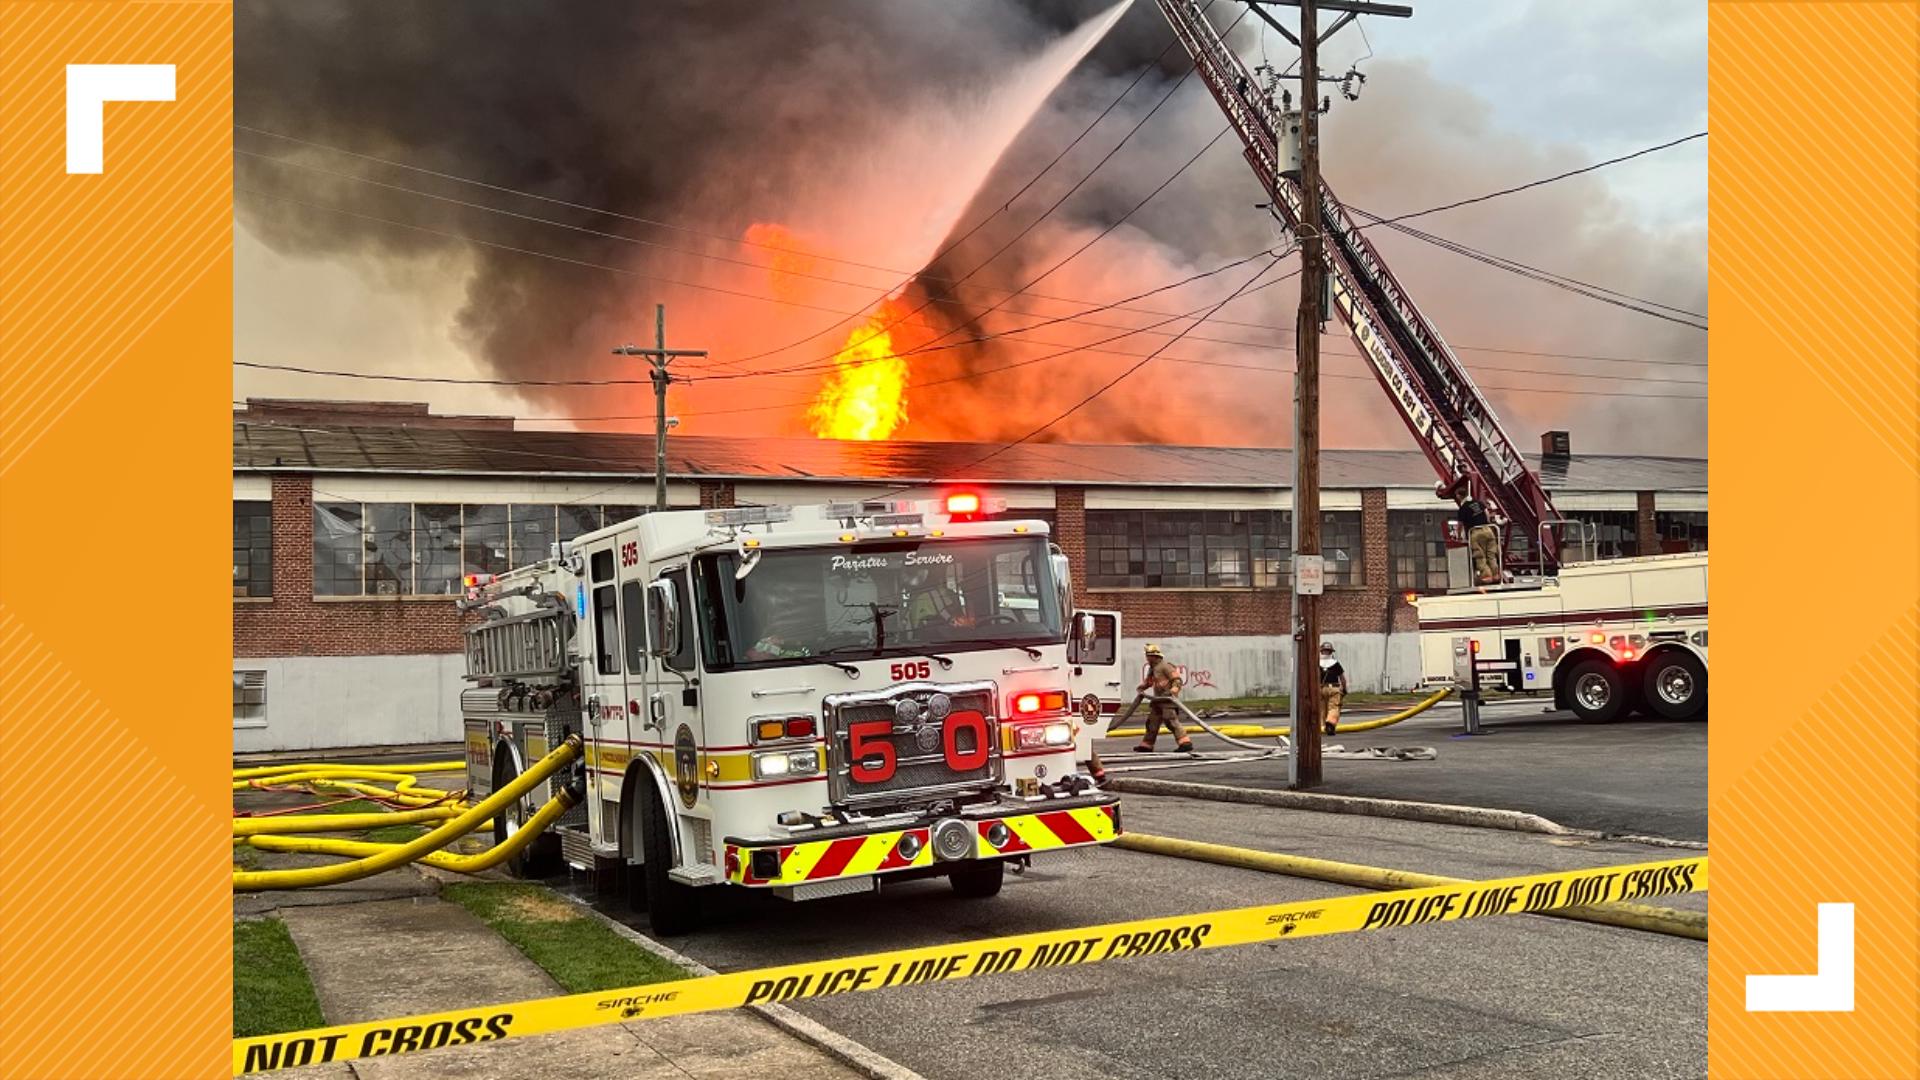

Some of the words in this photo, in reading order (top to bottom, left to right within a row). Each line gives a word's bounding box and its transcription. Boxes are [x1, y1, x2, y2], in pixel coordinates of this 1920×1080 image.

[621, 541, 639, 568] 505
[904, 551, 954, 566] Servire
[890, 660, 931, 681] 505
[1360, 893, 1462, 930] POLICE
[1459, 885, 1525, 919] LINE
[1521, 880, 1563, 913] DO
[1563, 873, 1620, 908] NOT
[1618, 863, 1700, 901] CROSS
[1265, 909, 1327, 926] SIRCHIE
[744, 966, 879, 1007] POLICE
[882, 953, 968, 988] LINE
[969, 947, 1023, 975] DO
[1026, 937, 1103, 970] NOT
[1100, 923, 1212, 961] CROSS
[597, 990, 680, 1011] SIRCHIE
[243, 1034, 348, 1073] NOT
[358, 1014, 514, 1058] CROSS
